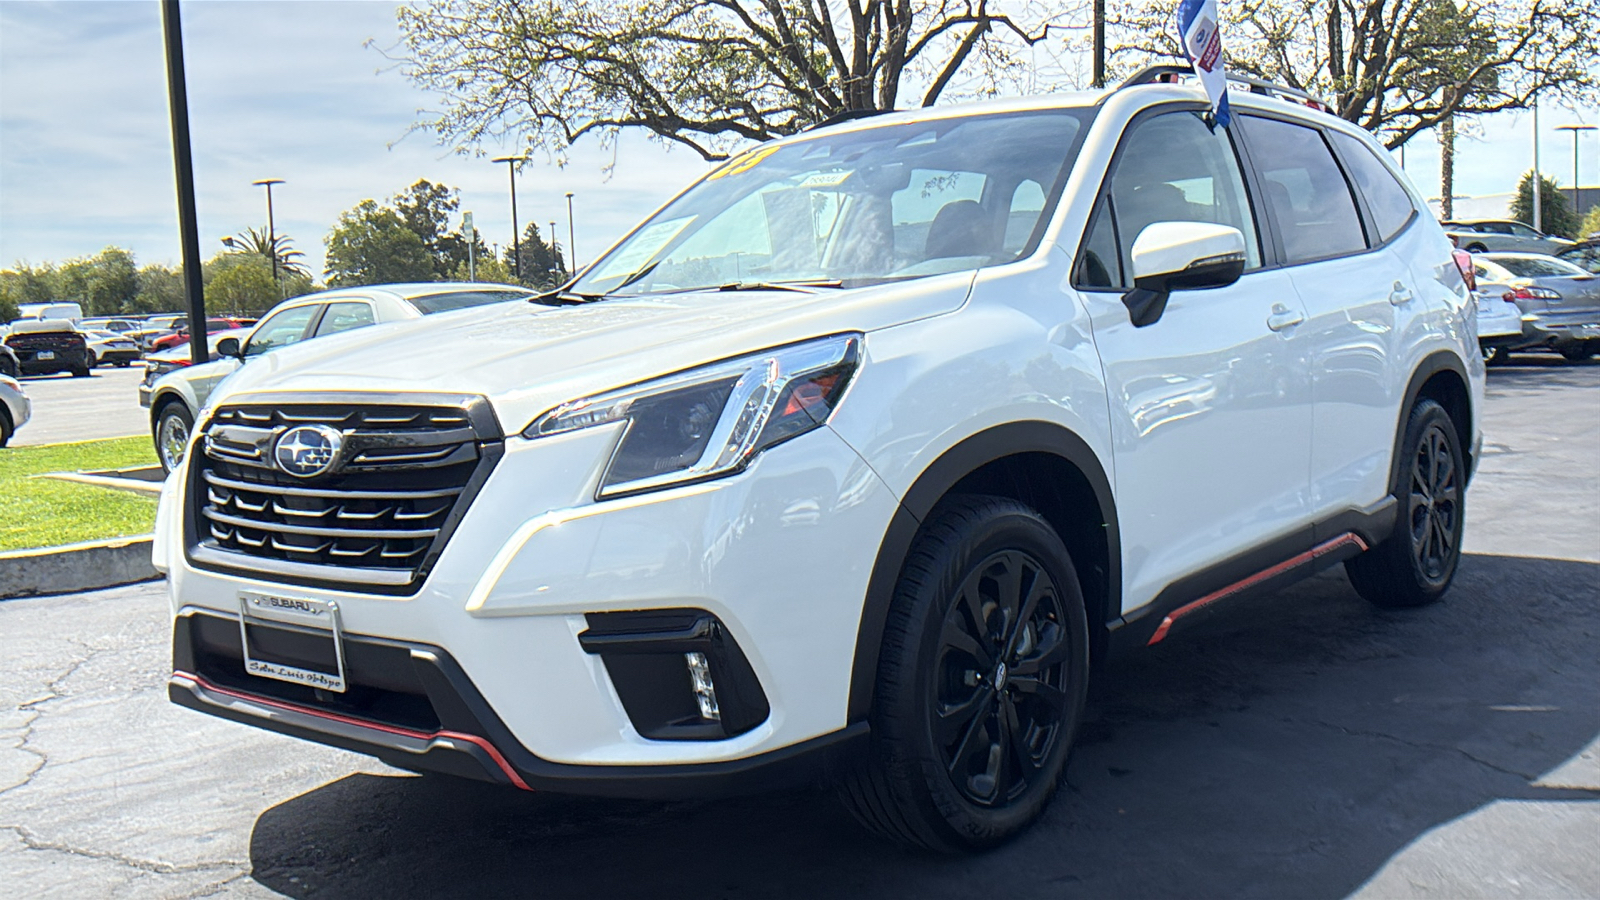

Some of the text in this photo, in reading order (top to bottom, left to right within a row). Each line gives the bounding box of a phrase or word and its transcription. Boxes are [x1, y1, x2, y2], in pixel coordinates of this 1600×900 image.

[270, 597, 310, 611] SUBARU
[249, 661, 275, 673] San
[278, 668, 304, 679] Luis
